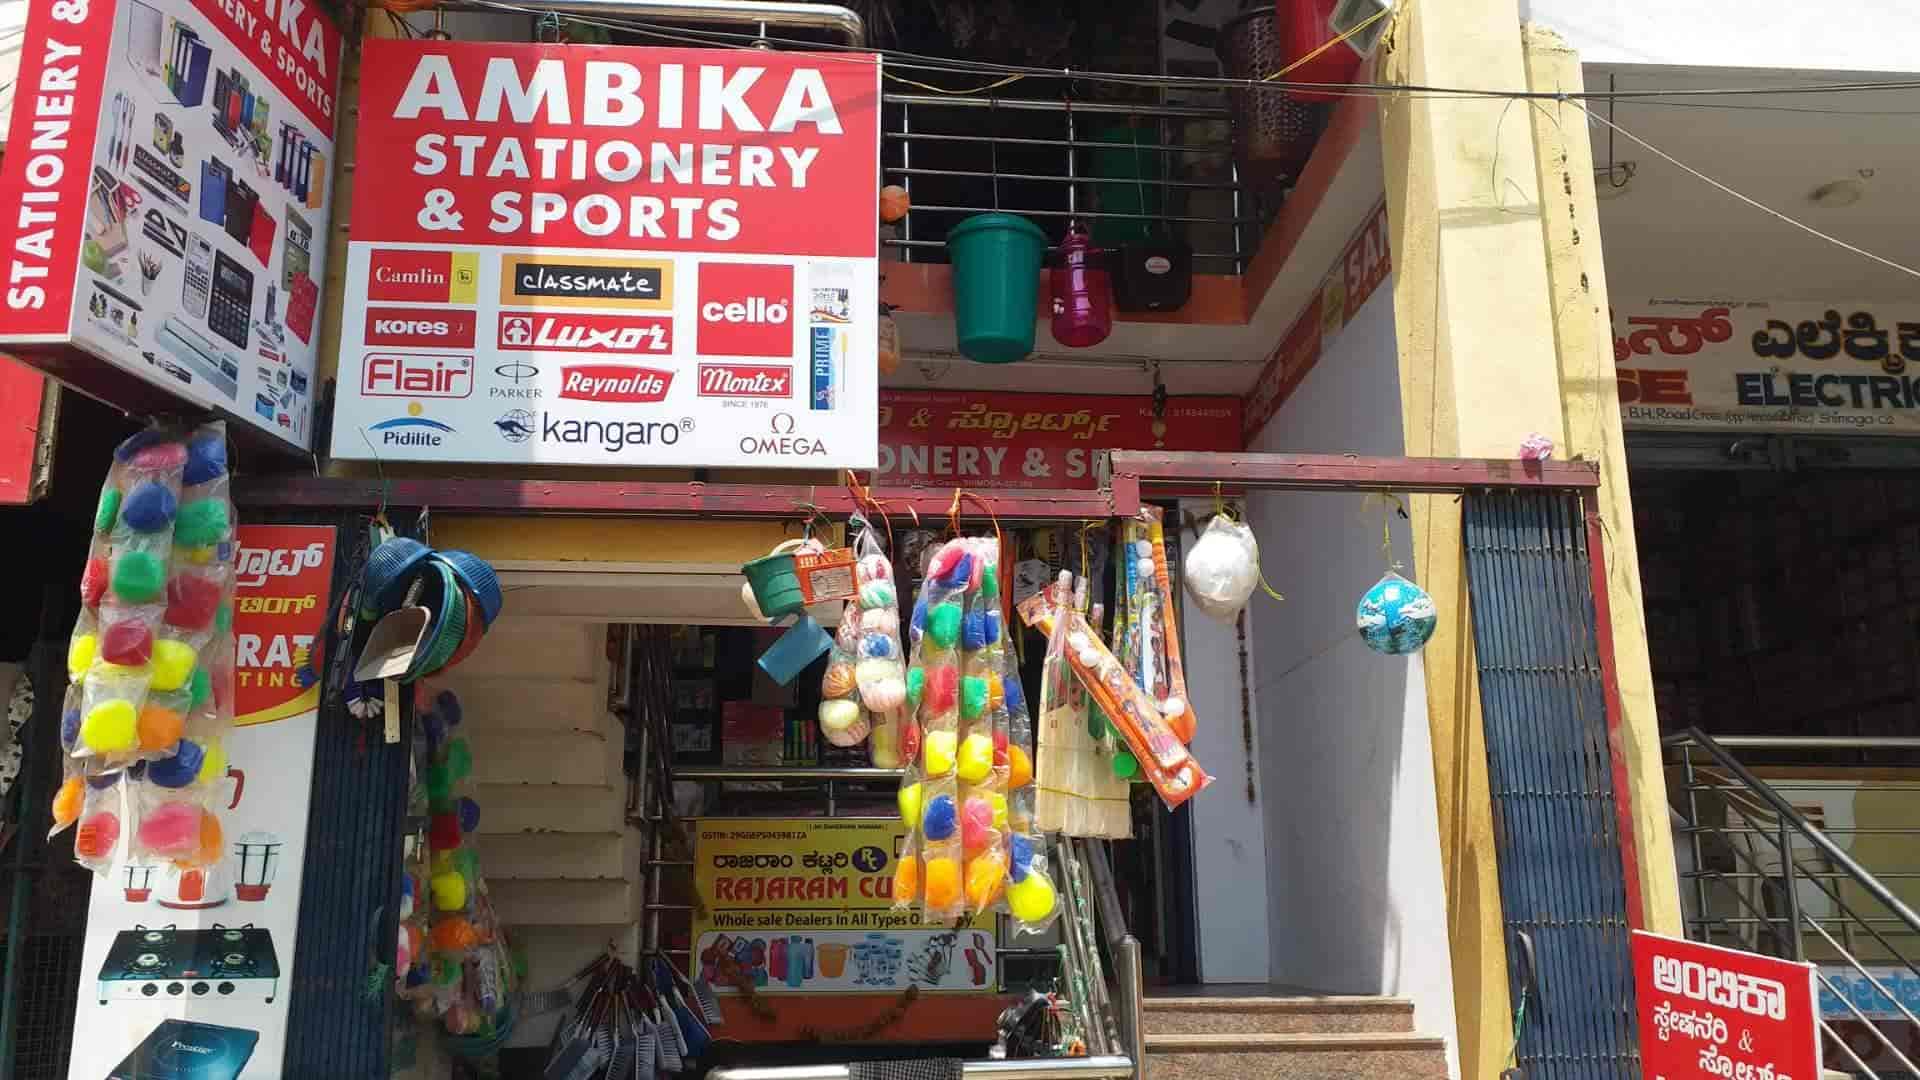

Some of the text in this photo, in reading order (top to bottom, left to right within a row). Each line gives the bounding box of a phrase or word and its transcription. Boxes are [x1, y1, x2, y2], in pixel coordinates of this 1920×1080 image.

[277, 46, 332, 117] SPORTS
[392, 54, 844, 134] AMBIKA
[8, 38, 82, 309] STATIONERY
[413, 134, 820, 189] STATIONERY
[416, 188, 741, 241] & SPORTS
[375, 263, 444, 285] Camlin
[702, 296, 788, 324] cello
[534, 318, 670, 350] Luxor
[489, 386, 542, 399] PARKER
[565, 371, 664, 395] Reynolds
[703, 367, 787, 393] Montex
[1736, 372, 1920, 410] ELECTRI
[722, 399, 748, 409] SINCE
[383, 431, 442, 447] Pidilite
[740, 437, 828, 456] OMEGA
[1022, 447, 1053, 478] &
[237, 634, 315, 668] RAT
[714, 876, 848, 903] RAJARAM
[713, 912, 754, 926] Whole
[757, 912, 782, 926] sale
[785, 912, 833, 926] Dealers
[851, 912, 868, 926] All
[872, 913, 907, 929] Types
[1652, 954, 1787, 1021] ಅಂಬಿಕಾ
[1738, 1029, 1755, 1052] &
